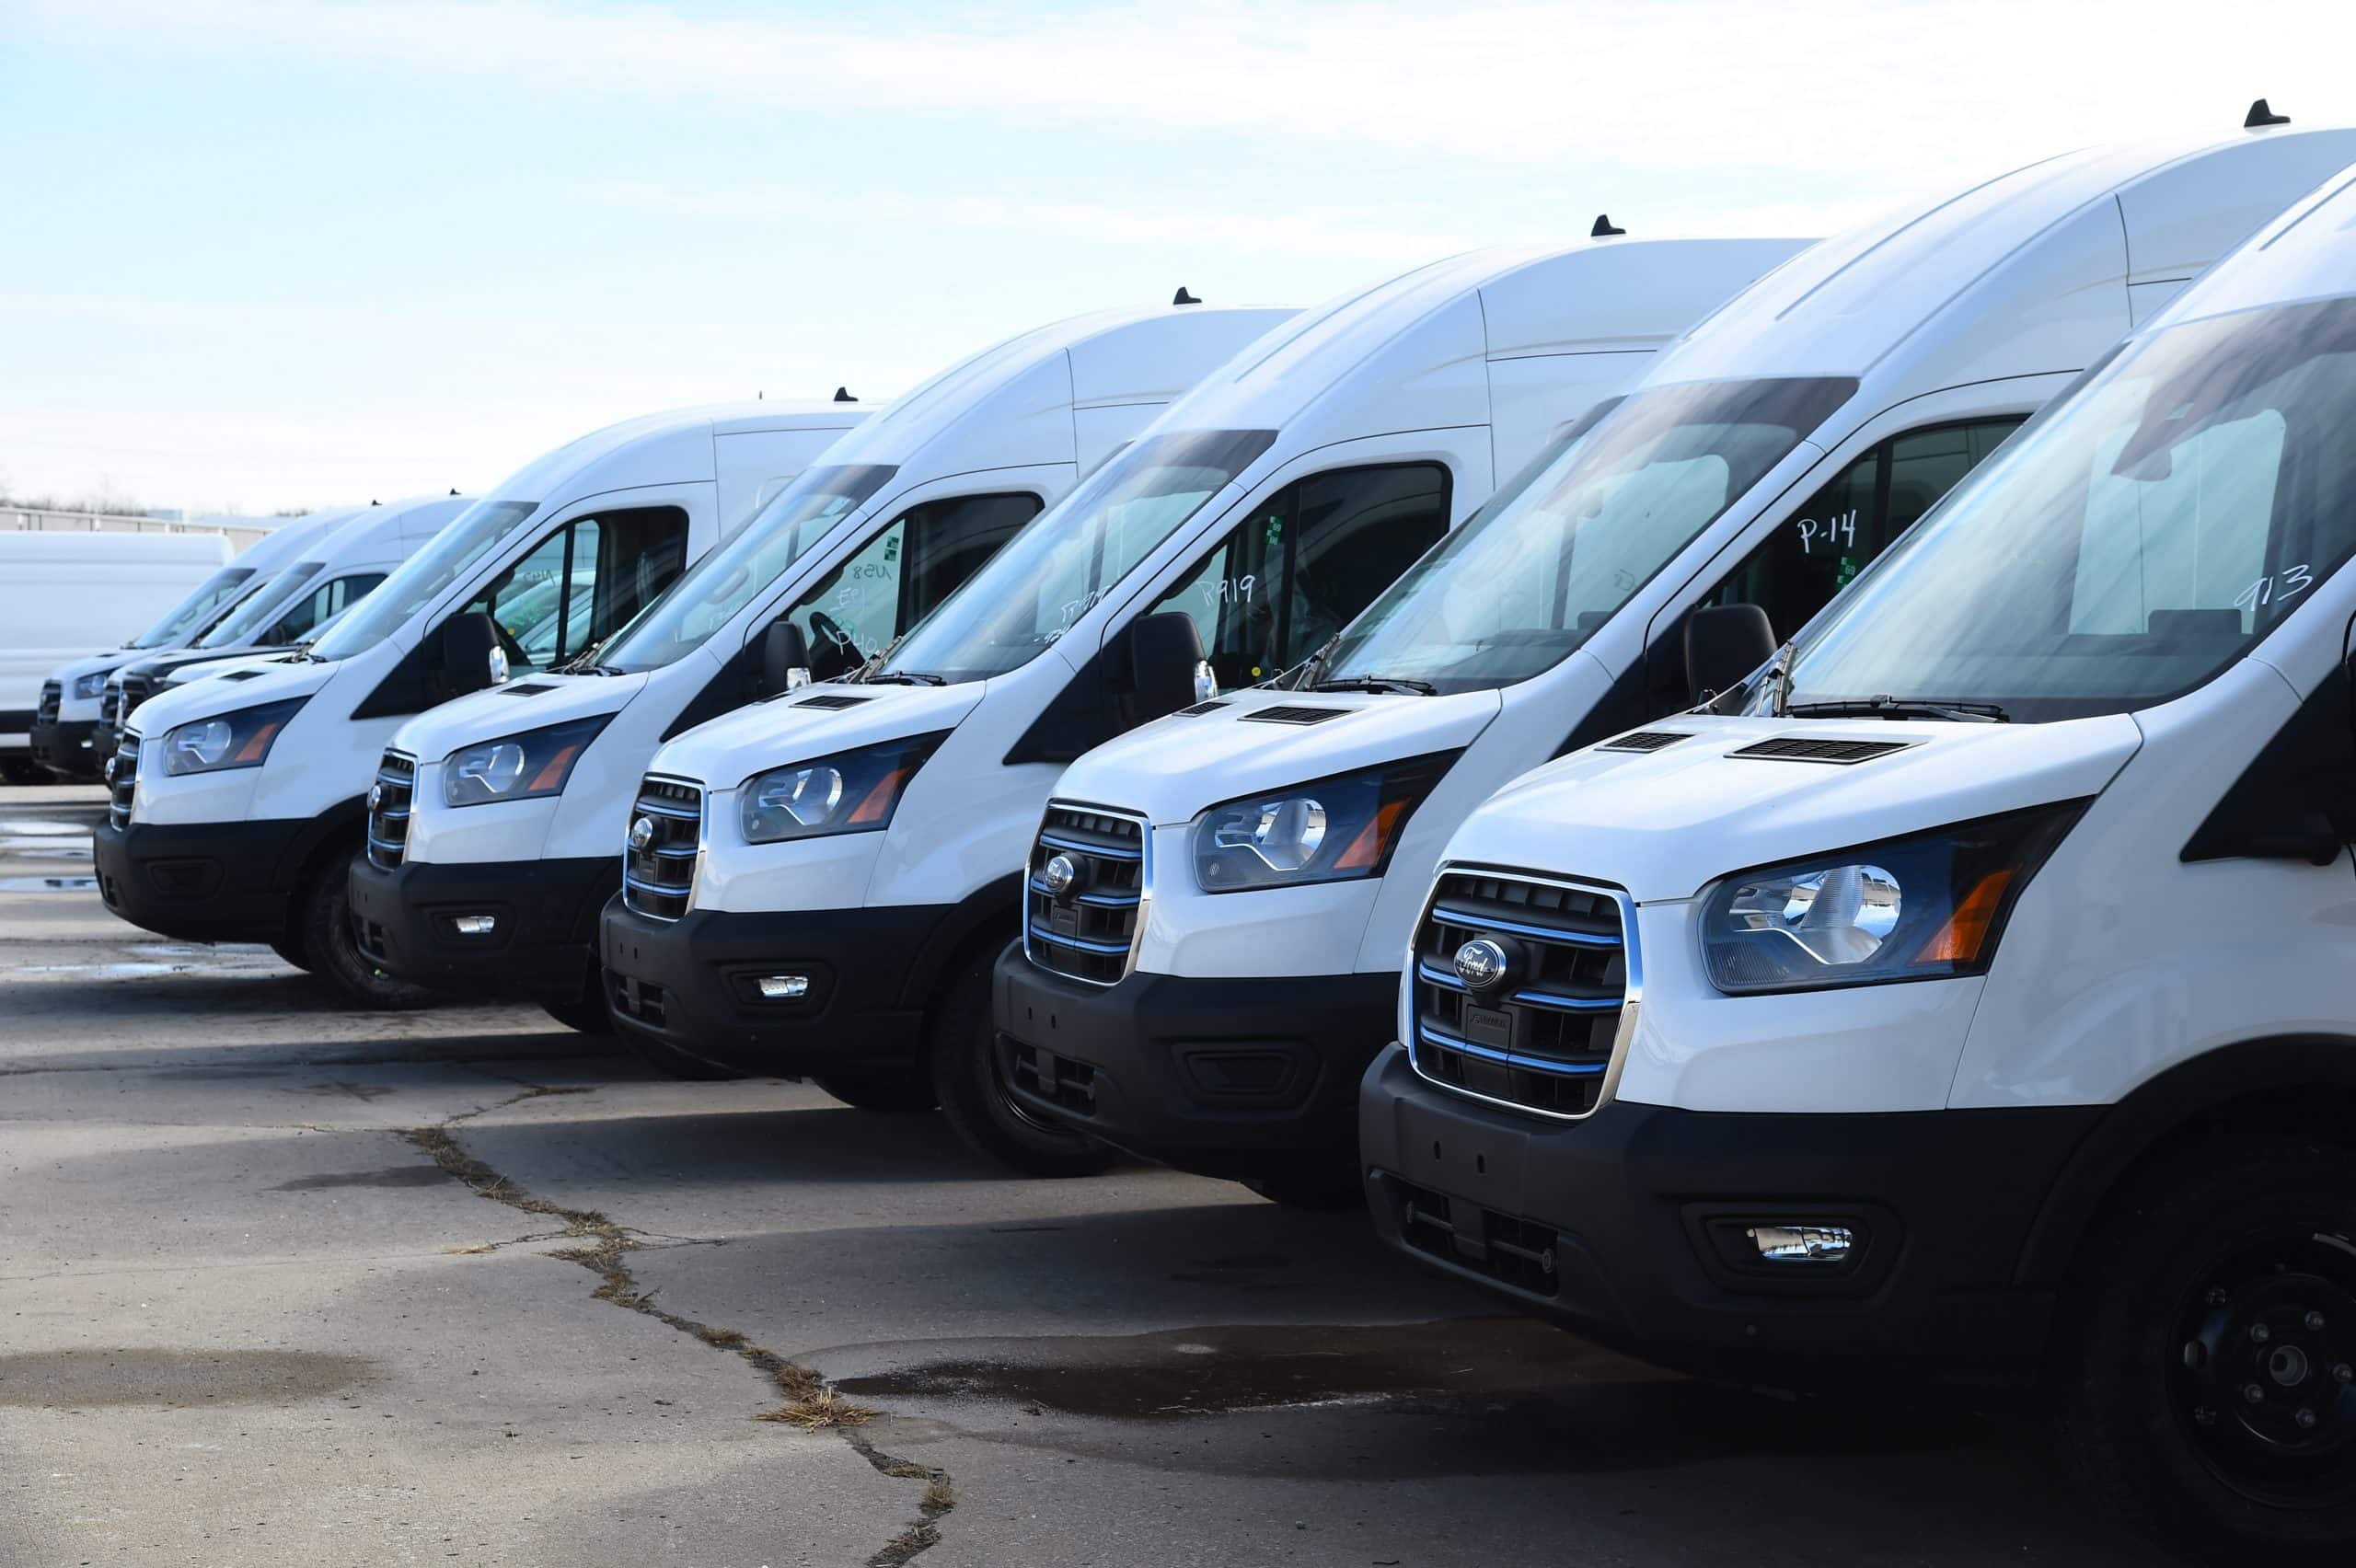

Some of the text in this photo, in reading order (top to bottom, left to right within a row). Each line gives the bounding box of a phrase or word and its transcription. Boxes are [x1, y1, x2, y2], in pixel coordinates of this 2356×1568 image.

[1796, 509, 1857, 554] P-14
[2233, 563, 2314, 612] 913
[1458, 946, 1489, 977] Ford
